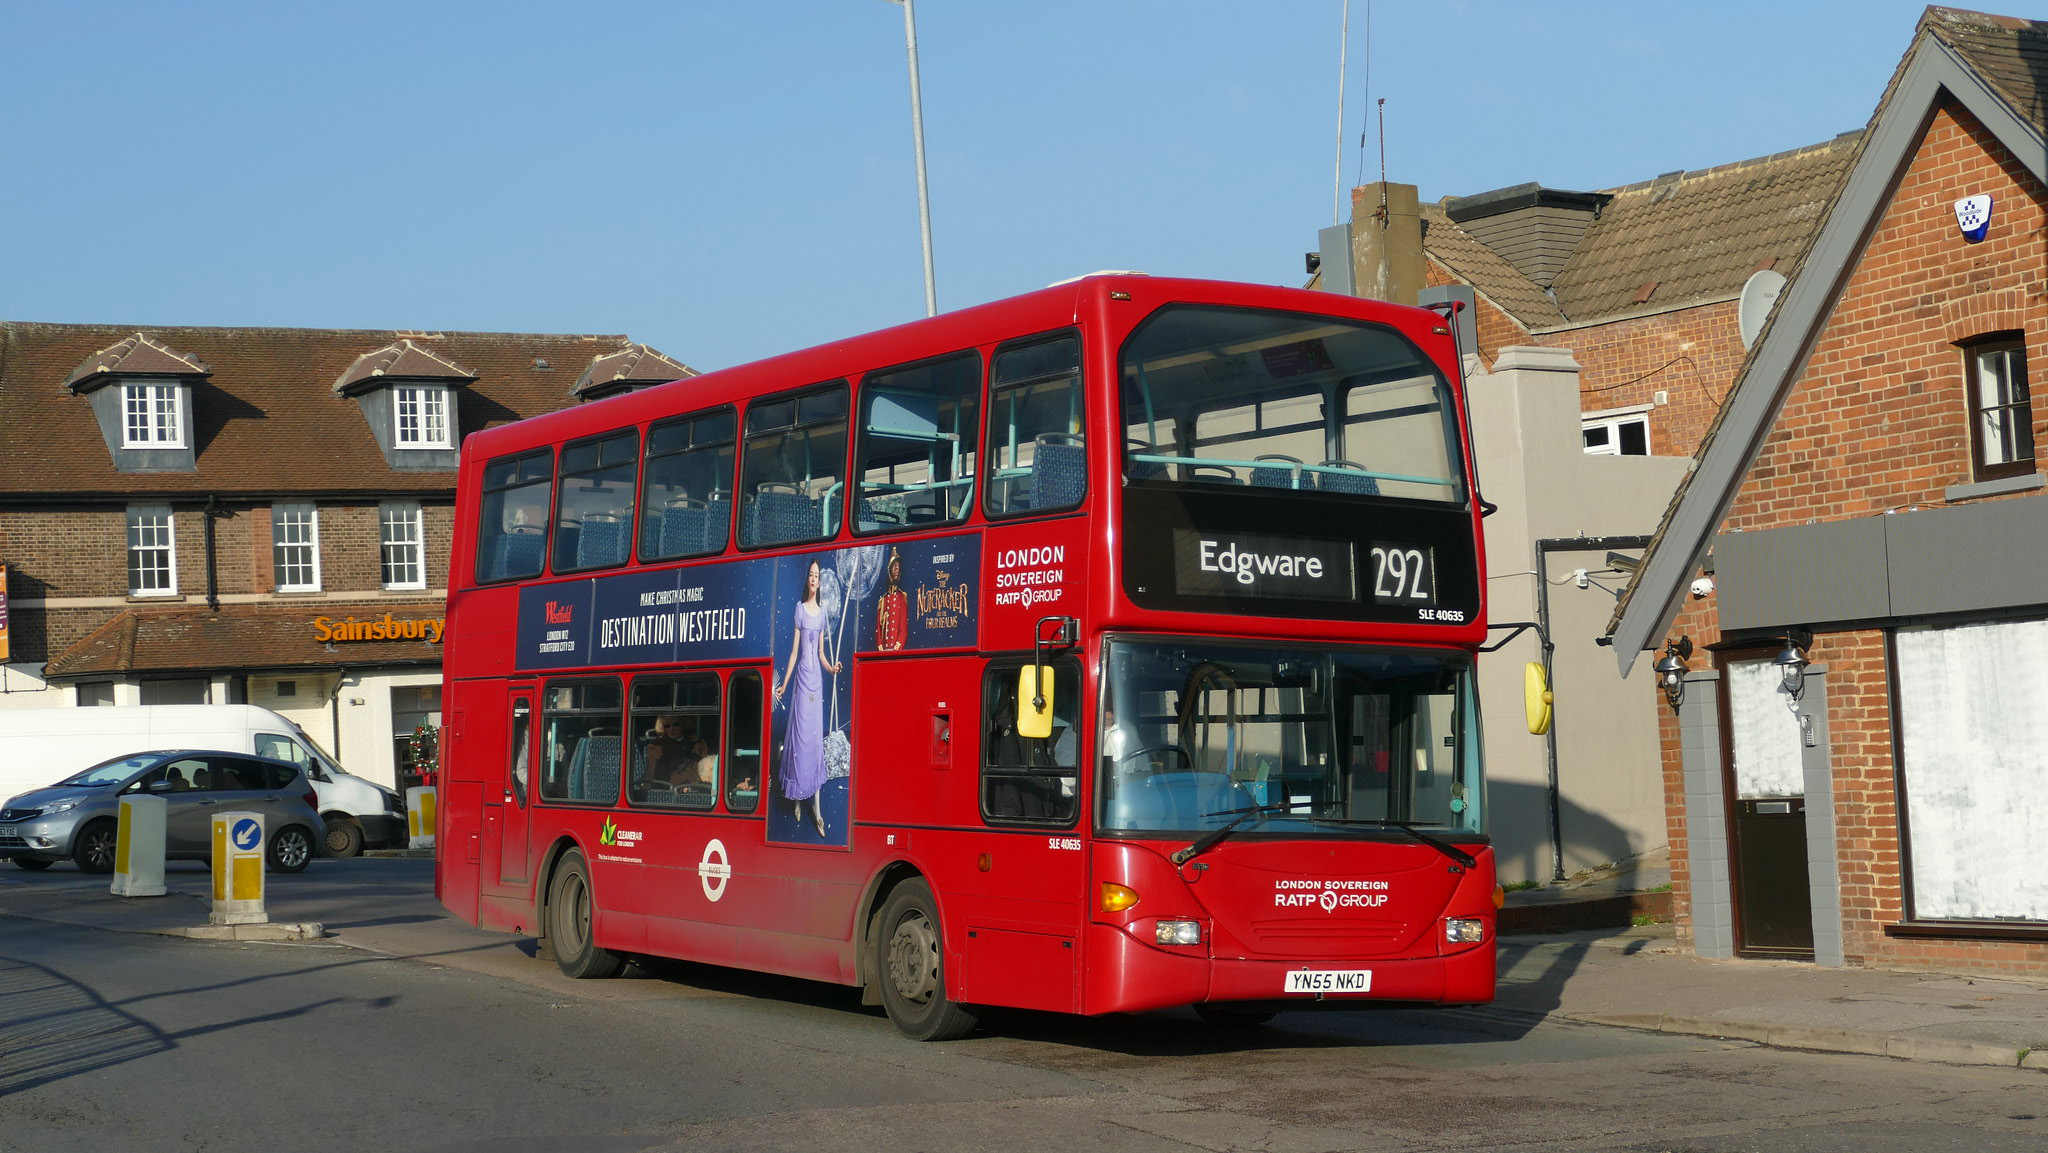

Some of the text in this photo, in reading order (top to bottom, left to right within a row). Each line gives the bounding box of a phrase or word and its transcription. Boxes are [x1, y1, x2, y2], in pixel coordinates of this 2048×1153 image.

[932, 553, 955, 564] INSPIRED BY
[997, 545, 1065, 569] LONDON
[1200, 540, 1323, 585] Edgware
[996, 569, 1063, 588] SOVEREIGN
[1371, 547, 1428, 599] 292
[939, 580, 947, 588] THE
[640, 587, 704, 606] MAKE CHRISTMAS MAGIC
[917, 583, 969, 621] NUTCRACKER
[995, 588, 1062, 606] RATP GROUP
[545, 600, 574, 624] Westfield
[1418, 608, 1464, 622] SLE 40635
[601, 607, 746, 649] DESTINATION WESTFIELD
[925, 615, 958, 630] FOUR REALMS
[547, 630, 561, 641] LONDON
[539, 642, 560, 653] STRATFORD
[886, 834, 895, 845] BT
[1048, 838, 1081, 851] SLE 40635
[1275, 880, 1389, 890] LONDON SOVEREIGN
[1275, 894, 1388, 907] RATP GROUP
[1293, 973, 1365, 989] YN55 NKD
